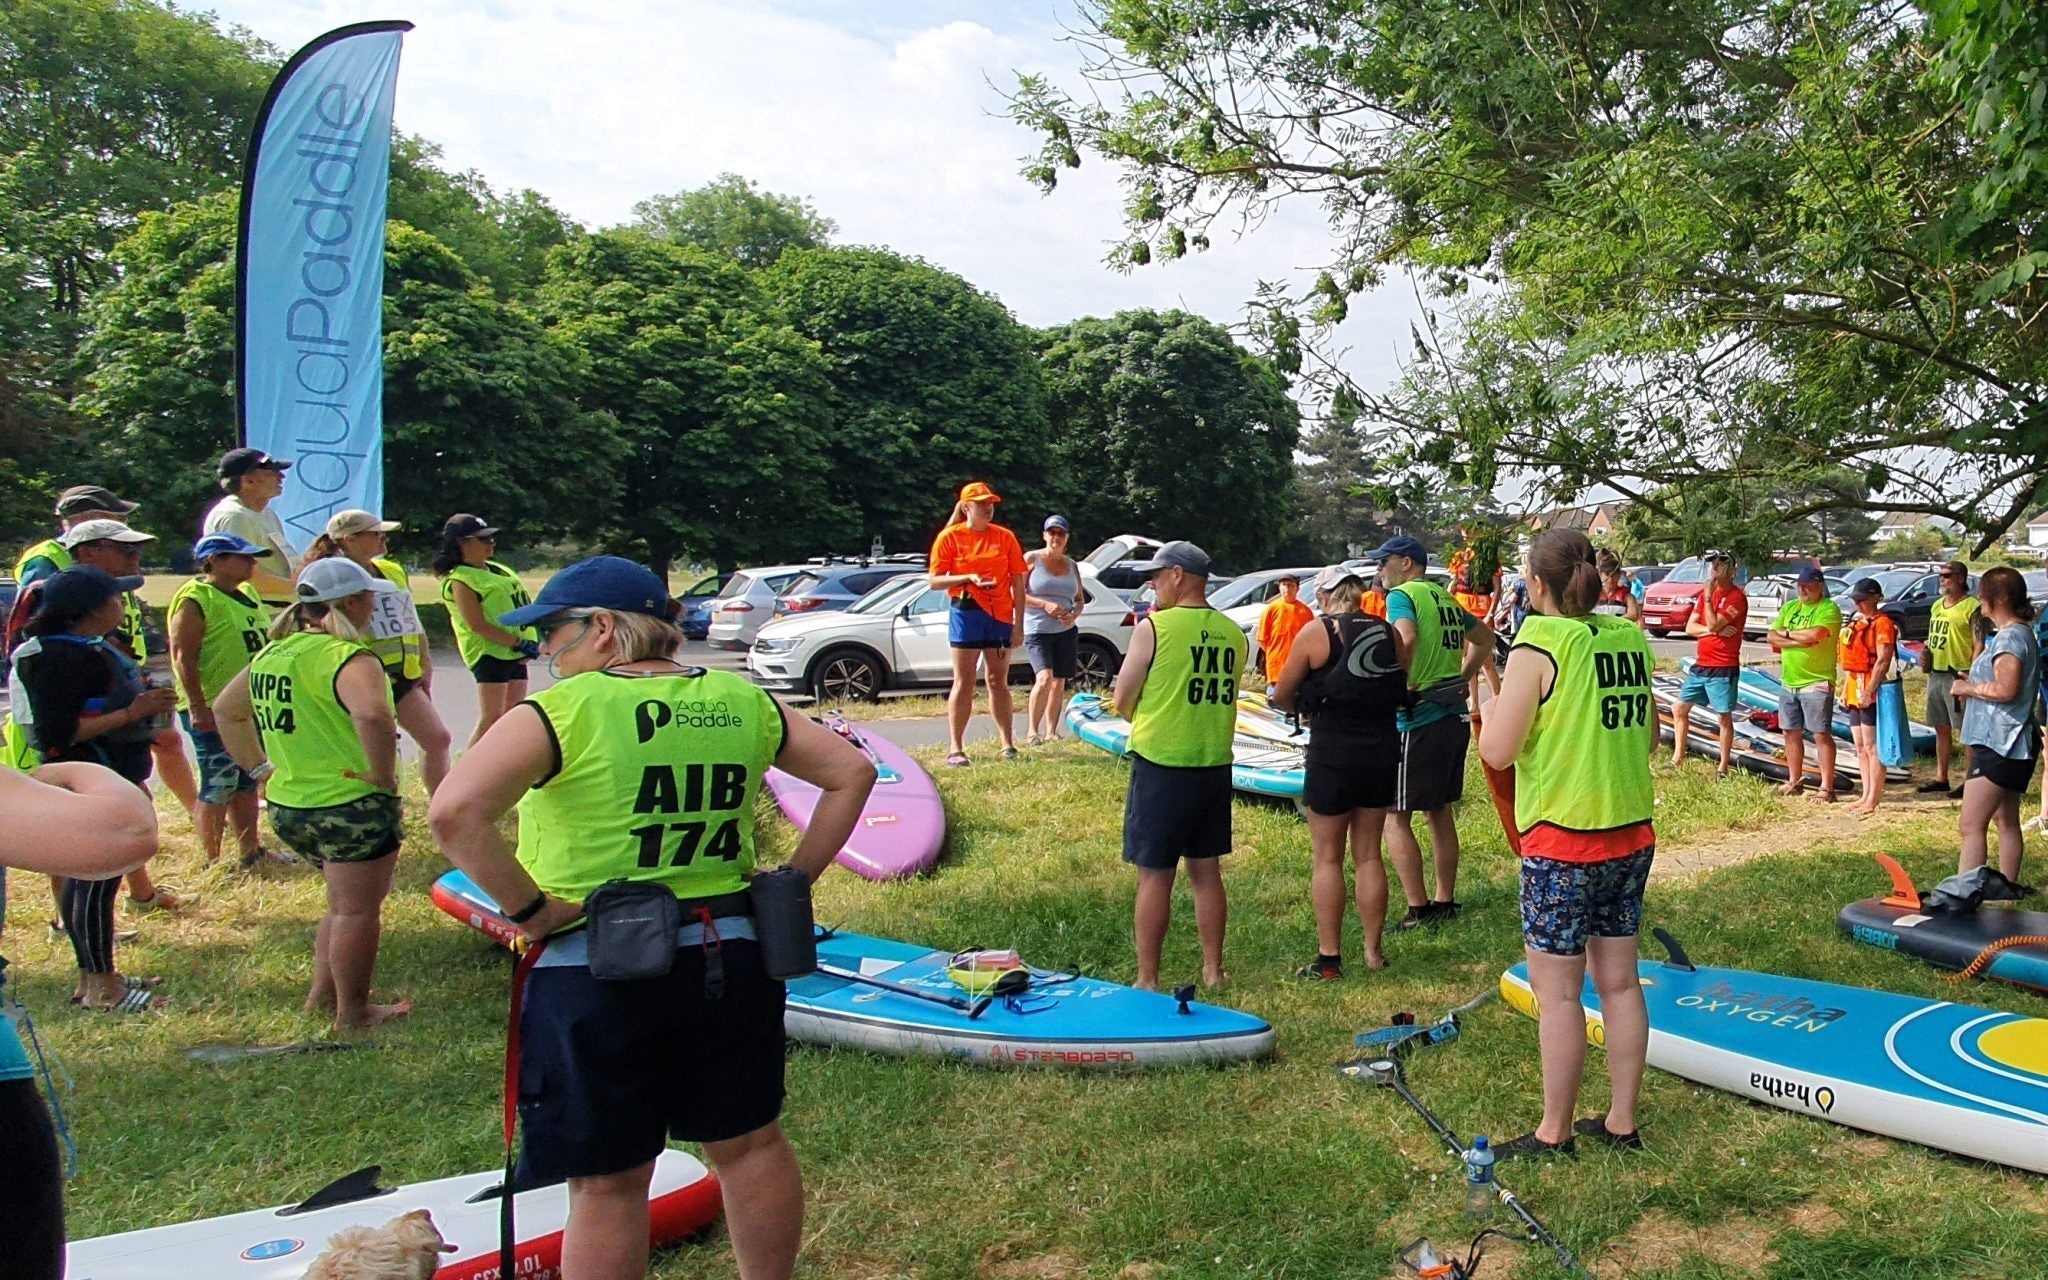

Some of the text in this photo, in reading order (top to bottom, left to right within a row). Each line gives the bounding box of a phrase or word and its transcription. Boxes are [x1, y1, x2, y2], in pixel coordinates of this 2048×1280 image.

[250, 672, 292, 704] WPG
[1594, 651, 1649, 689] DAX
[676, 700, 728, 715] Aqua
[1187, 677, 1235, 706] 643
[676, 713, 743, 728] Paddle
[1601, 693, 1649, 731] 678
[632, 763, 748, 814] AIB
[629, 818, 743, 868] 174
[1675, 996, 1829, 1034] OXYGEN
[1750, 1072, 1810, 1107] hatha
